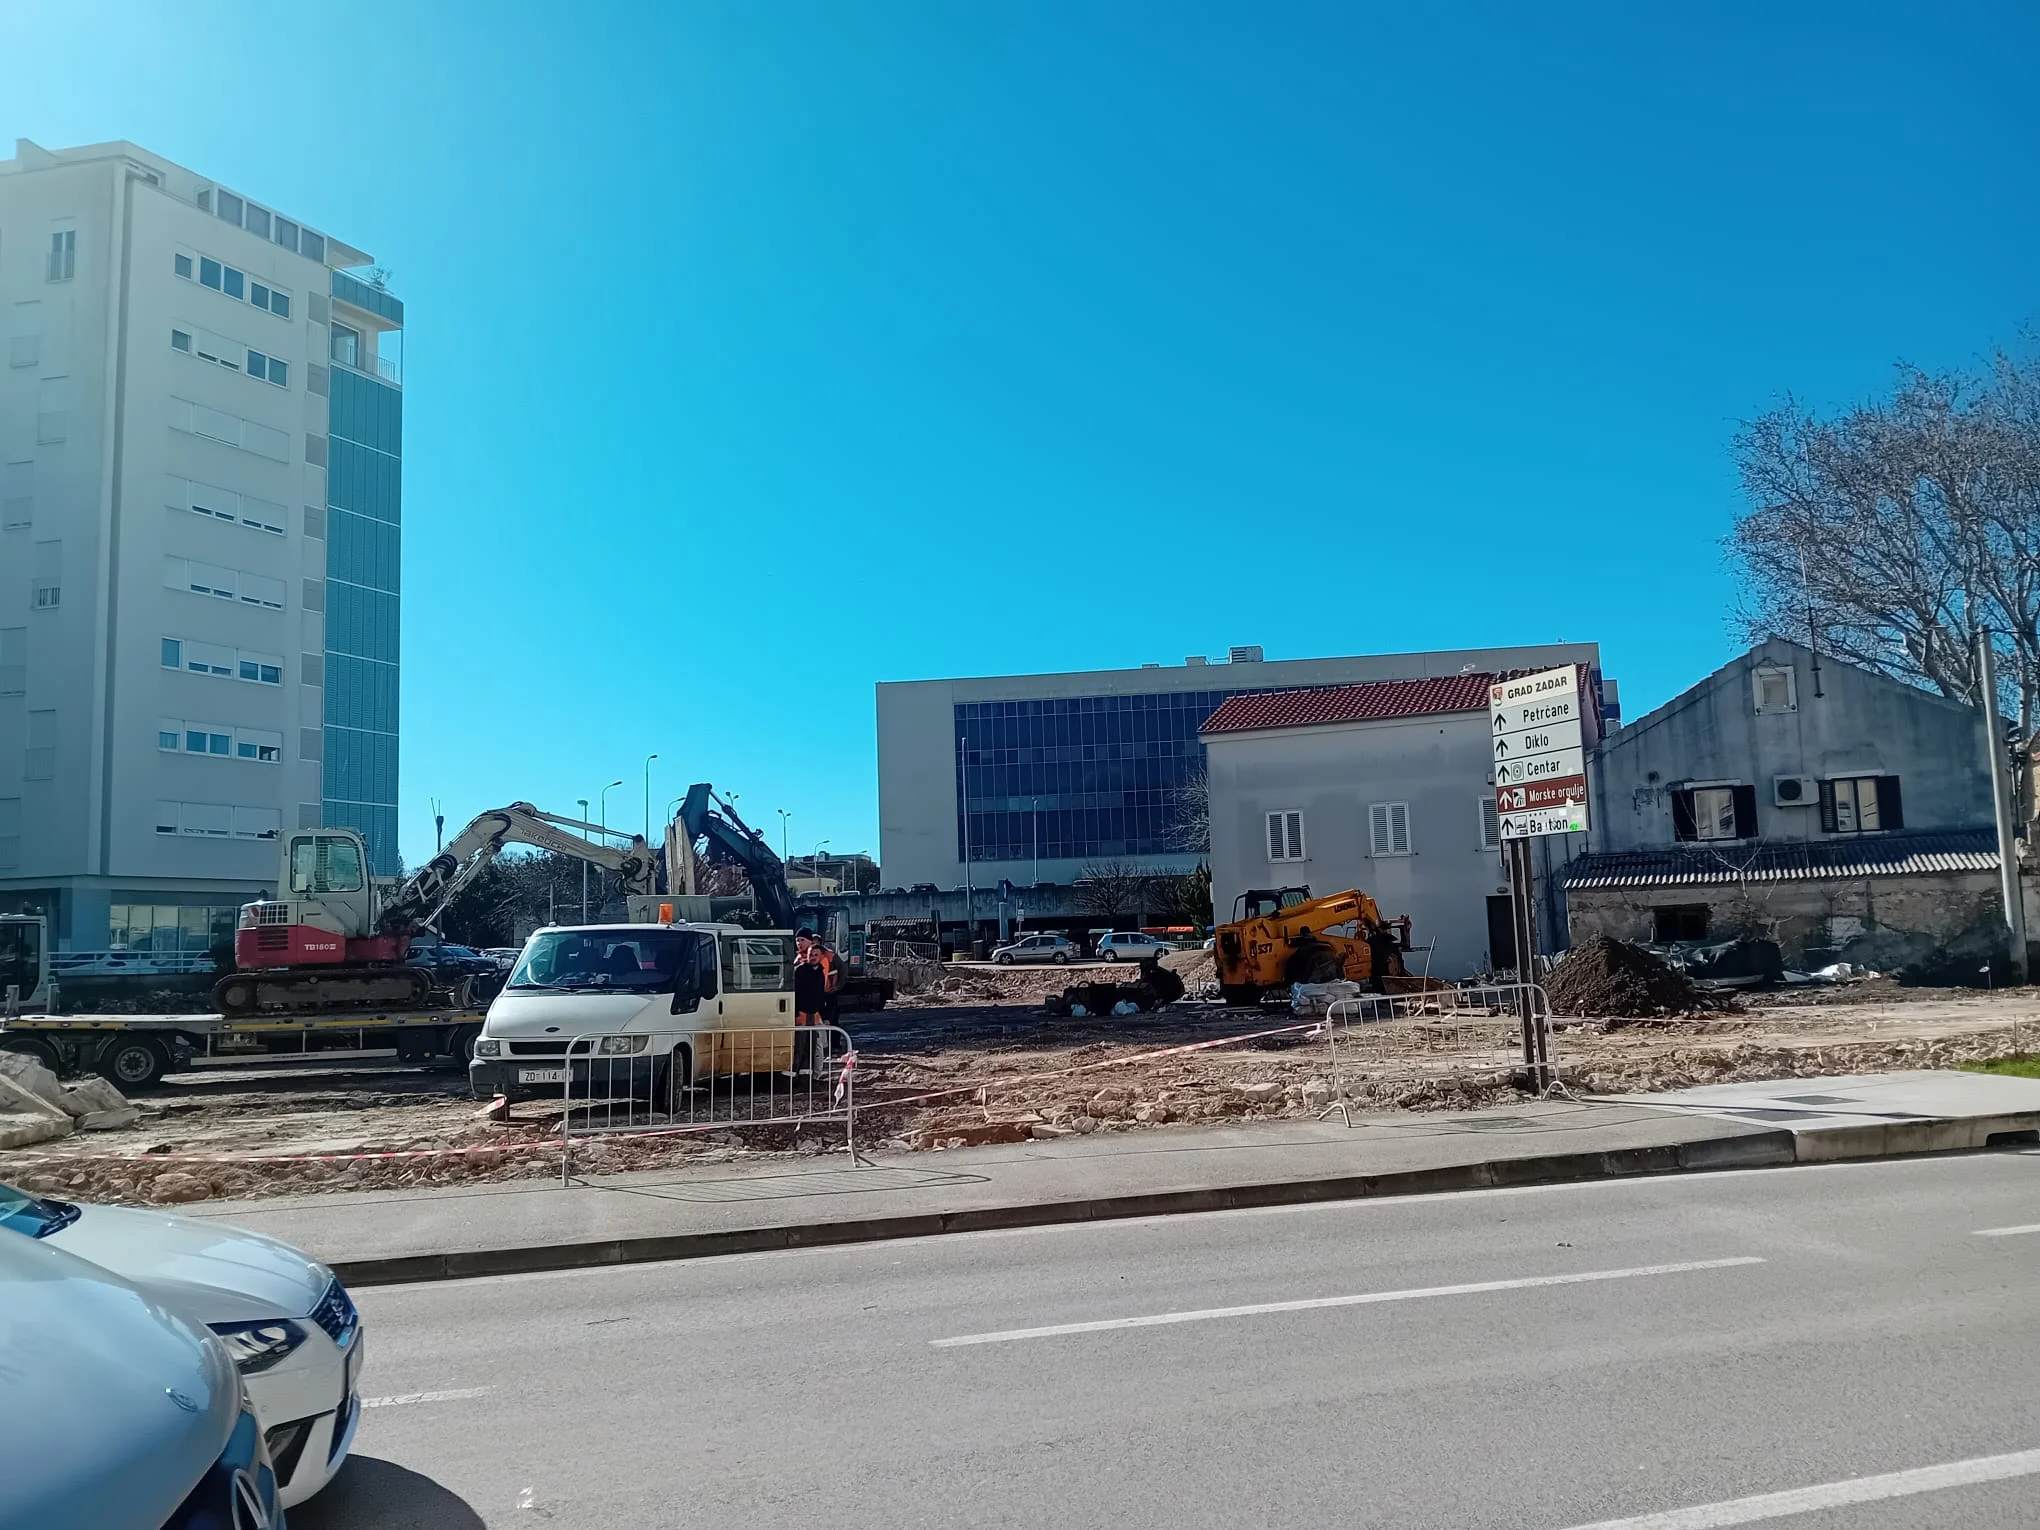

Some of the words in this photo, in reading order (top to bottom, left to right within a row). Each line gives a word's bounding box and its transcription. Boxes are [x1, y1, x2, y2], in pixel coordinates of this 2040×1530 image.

[1507, 685, 1533, 699] GRAD
[1535, 676, 1568, 692] ZADAR
[1523, 703, 1569, 723] Petrčane
[1525, 733, 1549, 749] Diklo
[1527, 760, 1560, 776] Centar
[1529, 787, 1556, 802] Morske
[1558, 783, 1584, 799] orgulje
[1529, 818, 1568, 833] Baton
